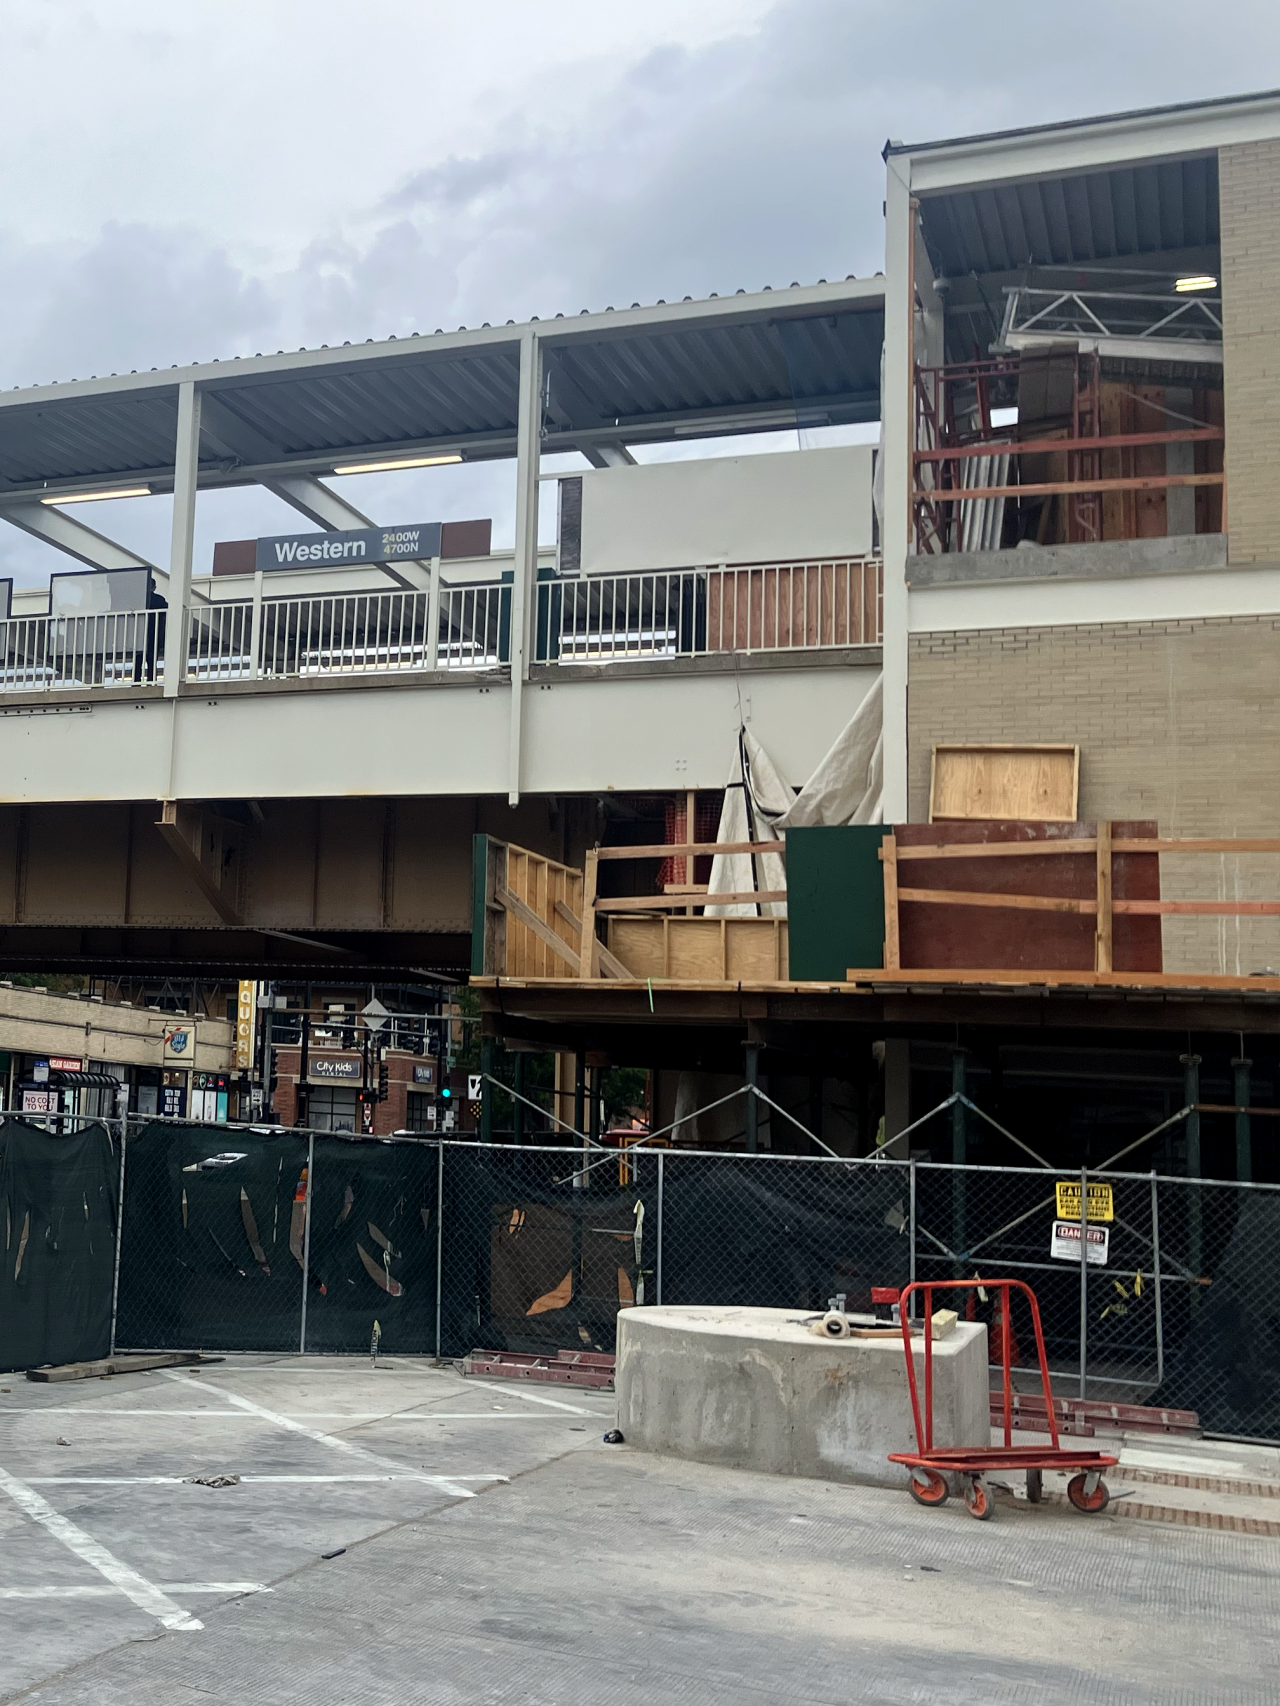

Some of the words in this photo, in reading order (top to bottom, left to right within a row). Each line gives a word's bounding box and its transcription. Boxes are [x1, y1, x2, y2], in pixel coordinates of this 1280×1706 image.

[382, 530, 420, 544] 2400W
[275, 540, 366, 563] Western
[383, 542, 419, 554] 4700N
[316, 1061, 334, 1072] City
[335, 1062, 353, 1072] Kids
[25, 1096, 36, 1104] NO
[1060, 1186, 1109, 1198] CAUION
[1060, 1203, 1110, 1211] PROTCTION
[1060, 1227, 1101, 1241] DANER
